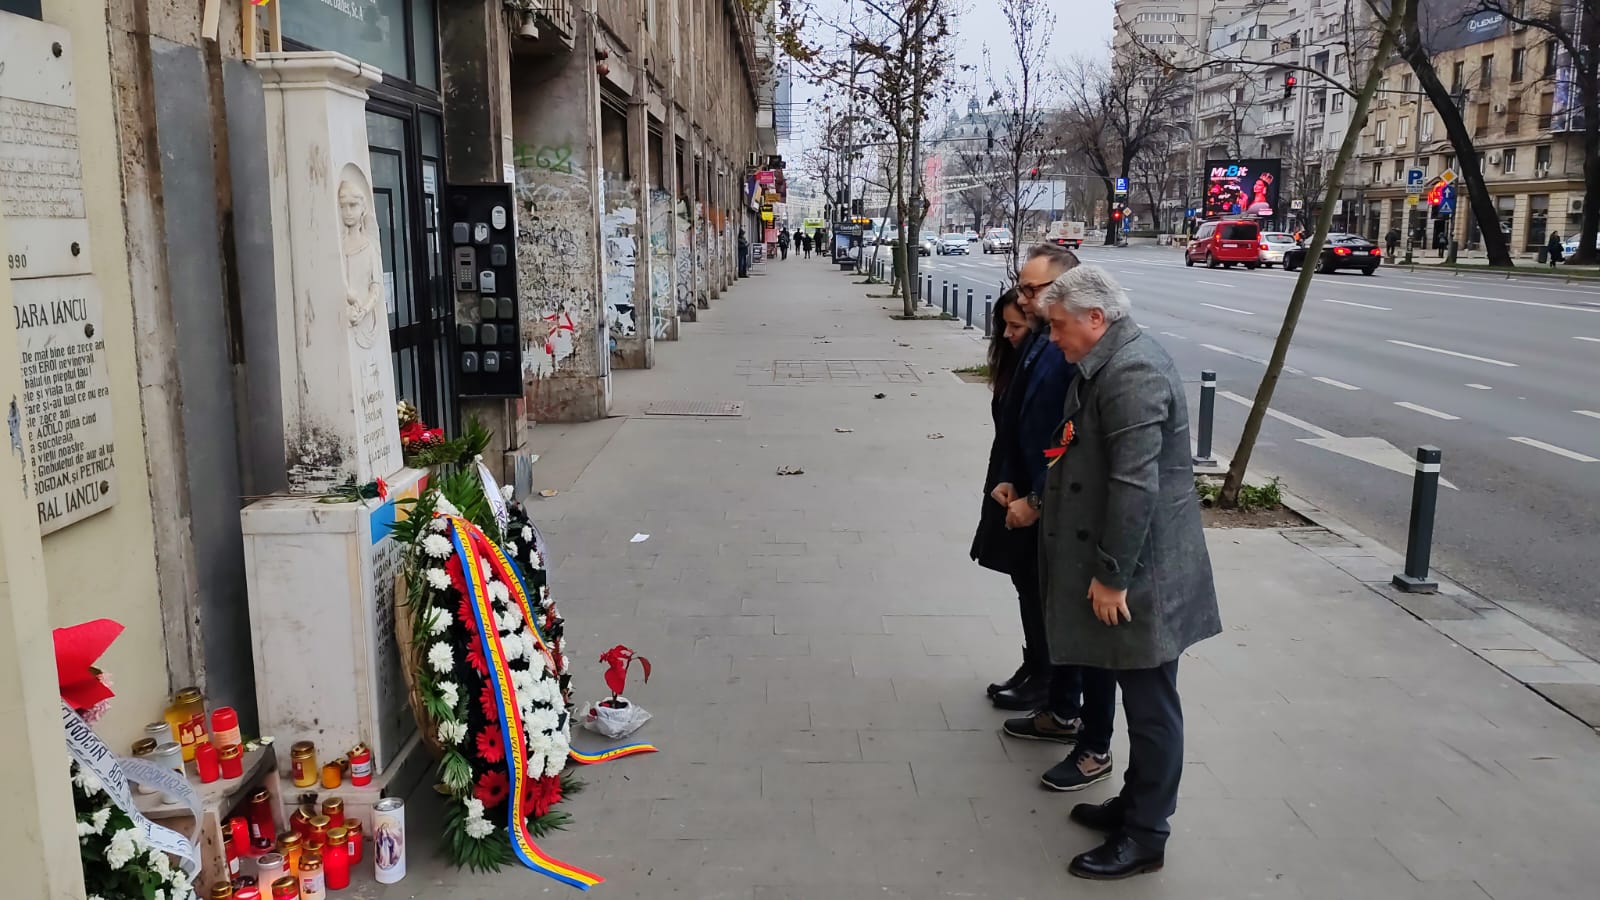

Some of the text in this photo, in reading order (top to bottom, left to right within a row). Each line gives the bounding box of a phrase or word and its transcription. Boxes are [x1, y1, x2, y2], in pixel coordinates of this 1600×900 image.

[1477, 14, 1503, 28] LEXUS
[1210, 165, 1248, 176] MrBit
[1408, 170, 1423, 184] P
[8, 254, 26, 269] 990
[51, 298, 87, 324] IANCU
[22, 352, 32, 364] De
[50, 346, 65, 358] bine
[67, 344, 75, 355] de
[78, 342, 93, 354] zece
[39, 360, 57, 374] EROI
[76, 380, 86, 390] dar
[24, 403, 40, 416] are
[78, 392, 86, 402] ce
[98, 386, 109, 398] era
[40, 412, 57, 425] zece
[60, 407, 70, 419] ani
[37, 421, 63, 439] ACOLO
[76, 453, 84, 463] de
[99, 445, 105, 456] al
[65, 480, 98, 513] IANCU
[62, 707, 108, 762] NICIODA
